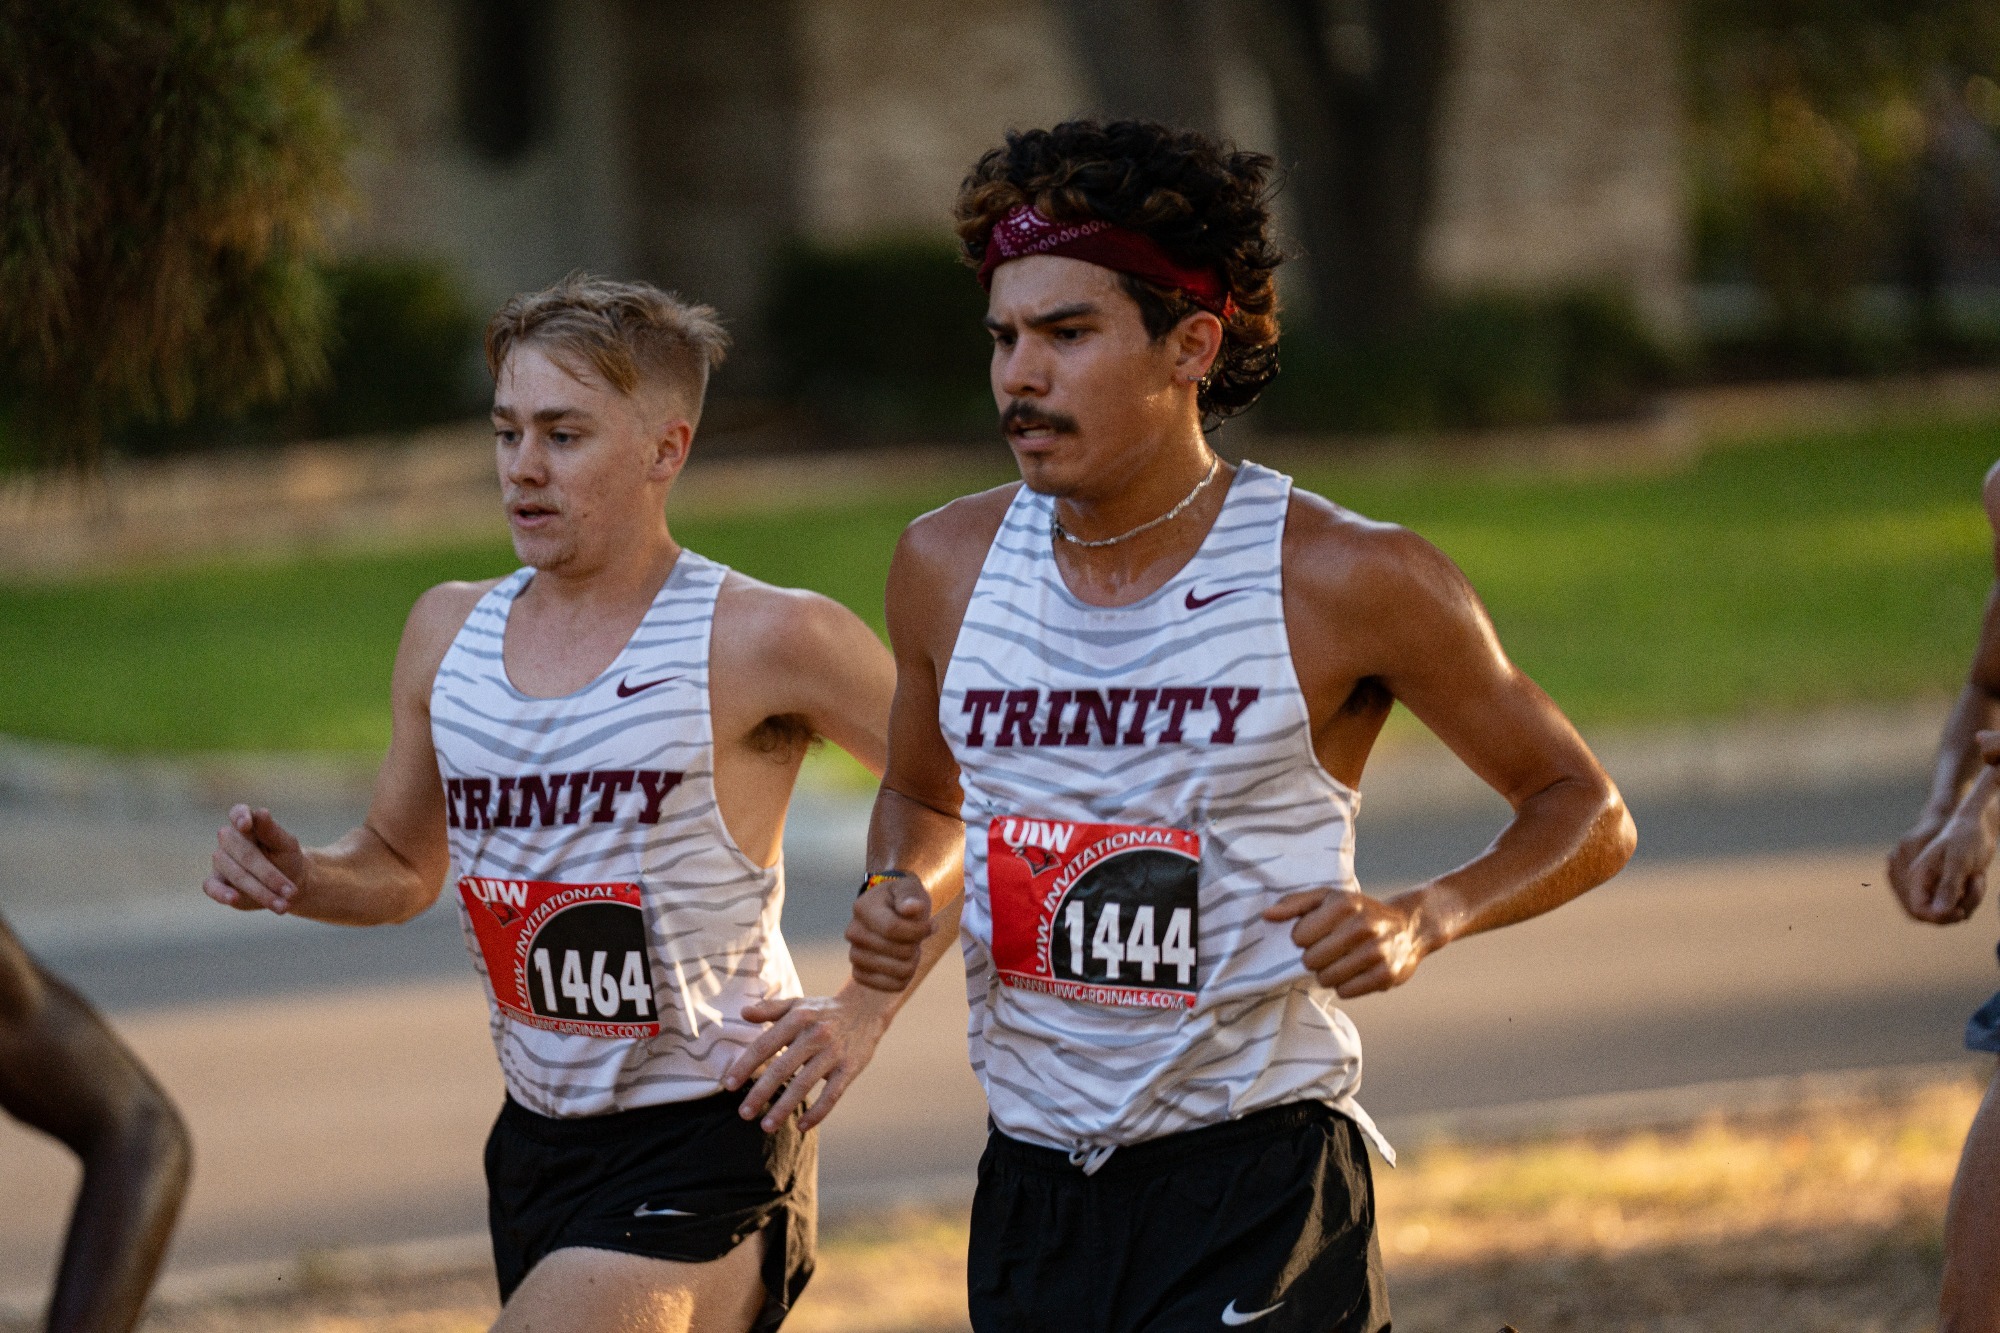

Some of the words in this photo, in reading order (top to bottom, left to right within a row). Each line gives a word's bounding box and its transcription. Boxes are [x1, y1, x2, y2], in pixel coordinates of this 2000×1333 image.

[961, 687, 1260, 747] TRINITY
[447, 769, 684, 830] TRINITY
[1002, 819, 1074, 853] UIW
[465, 878, 528, 908] UIW
[515, 886, 616, 959] INVITATIONAL
[1035, 914, 1050, 974] UIW
[1043, 830, 1173, 912] INVITATIONAL
[1064, 900, 1196, 985] 1444
[512, 959, 527, 1009] UIW
[533, 948, 652, 1018] 1464
